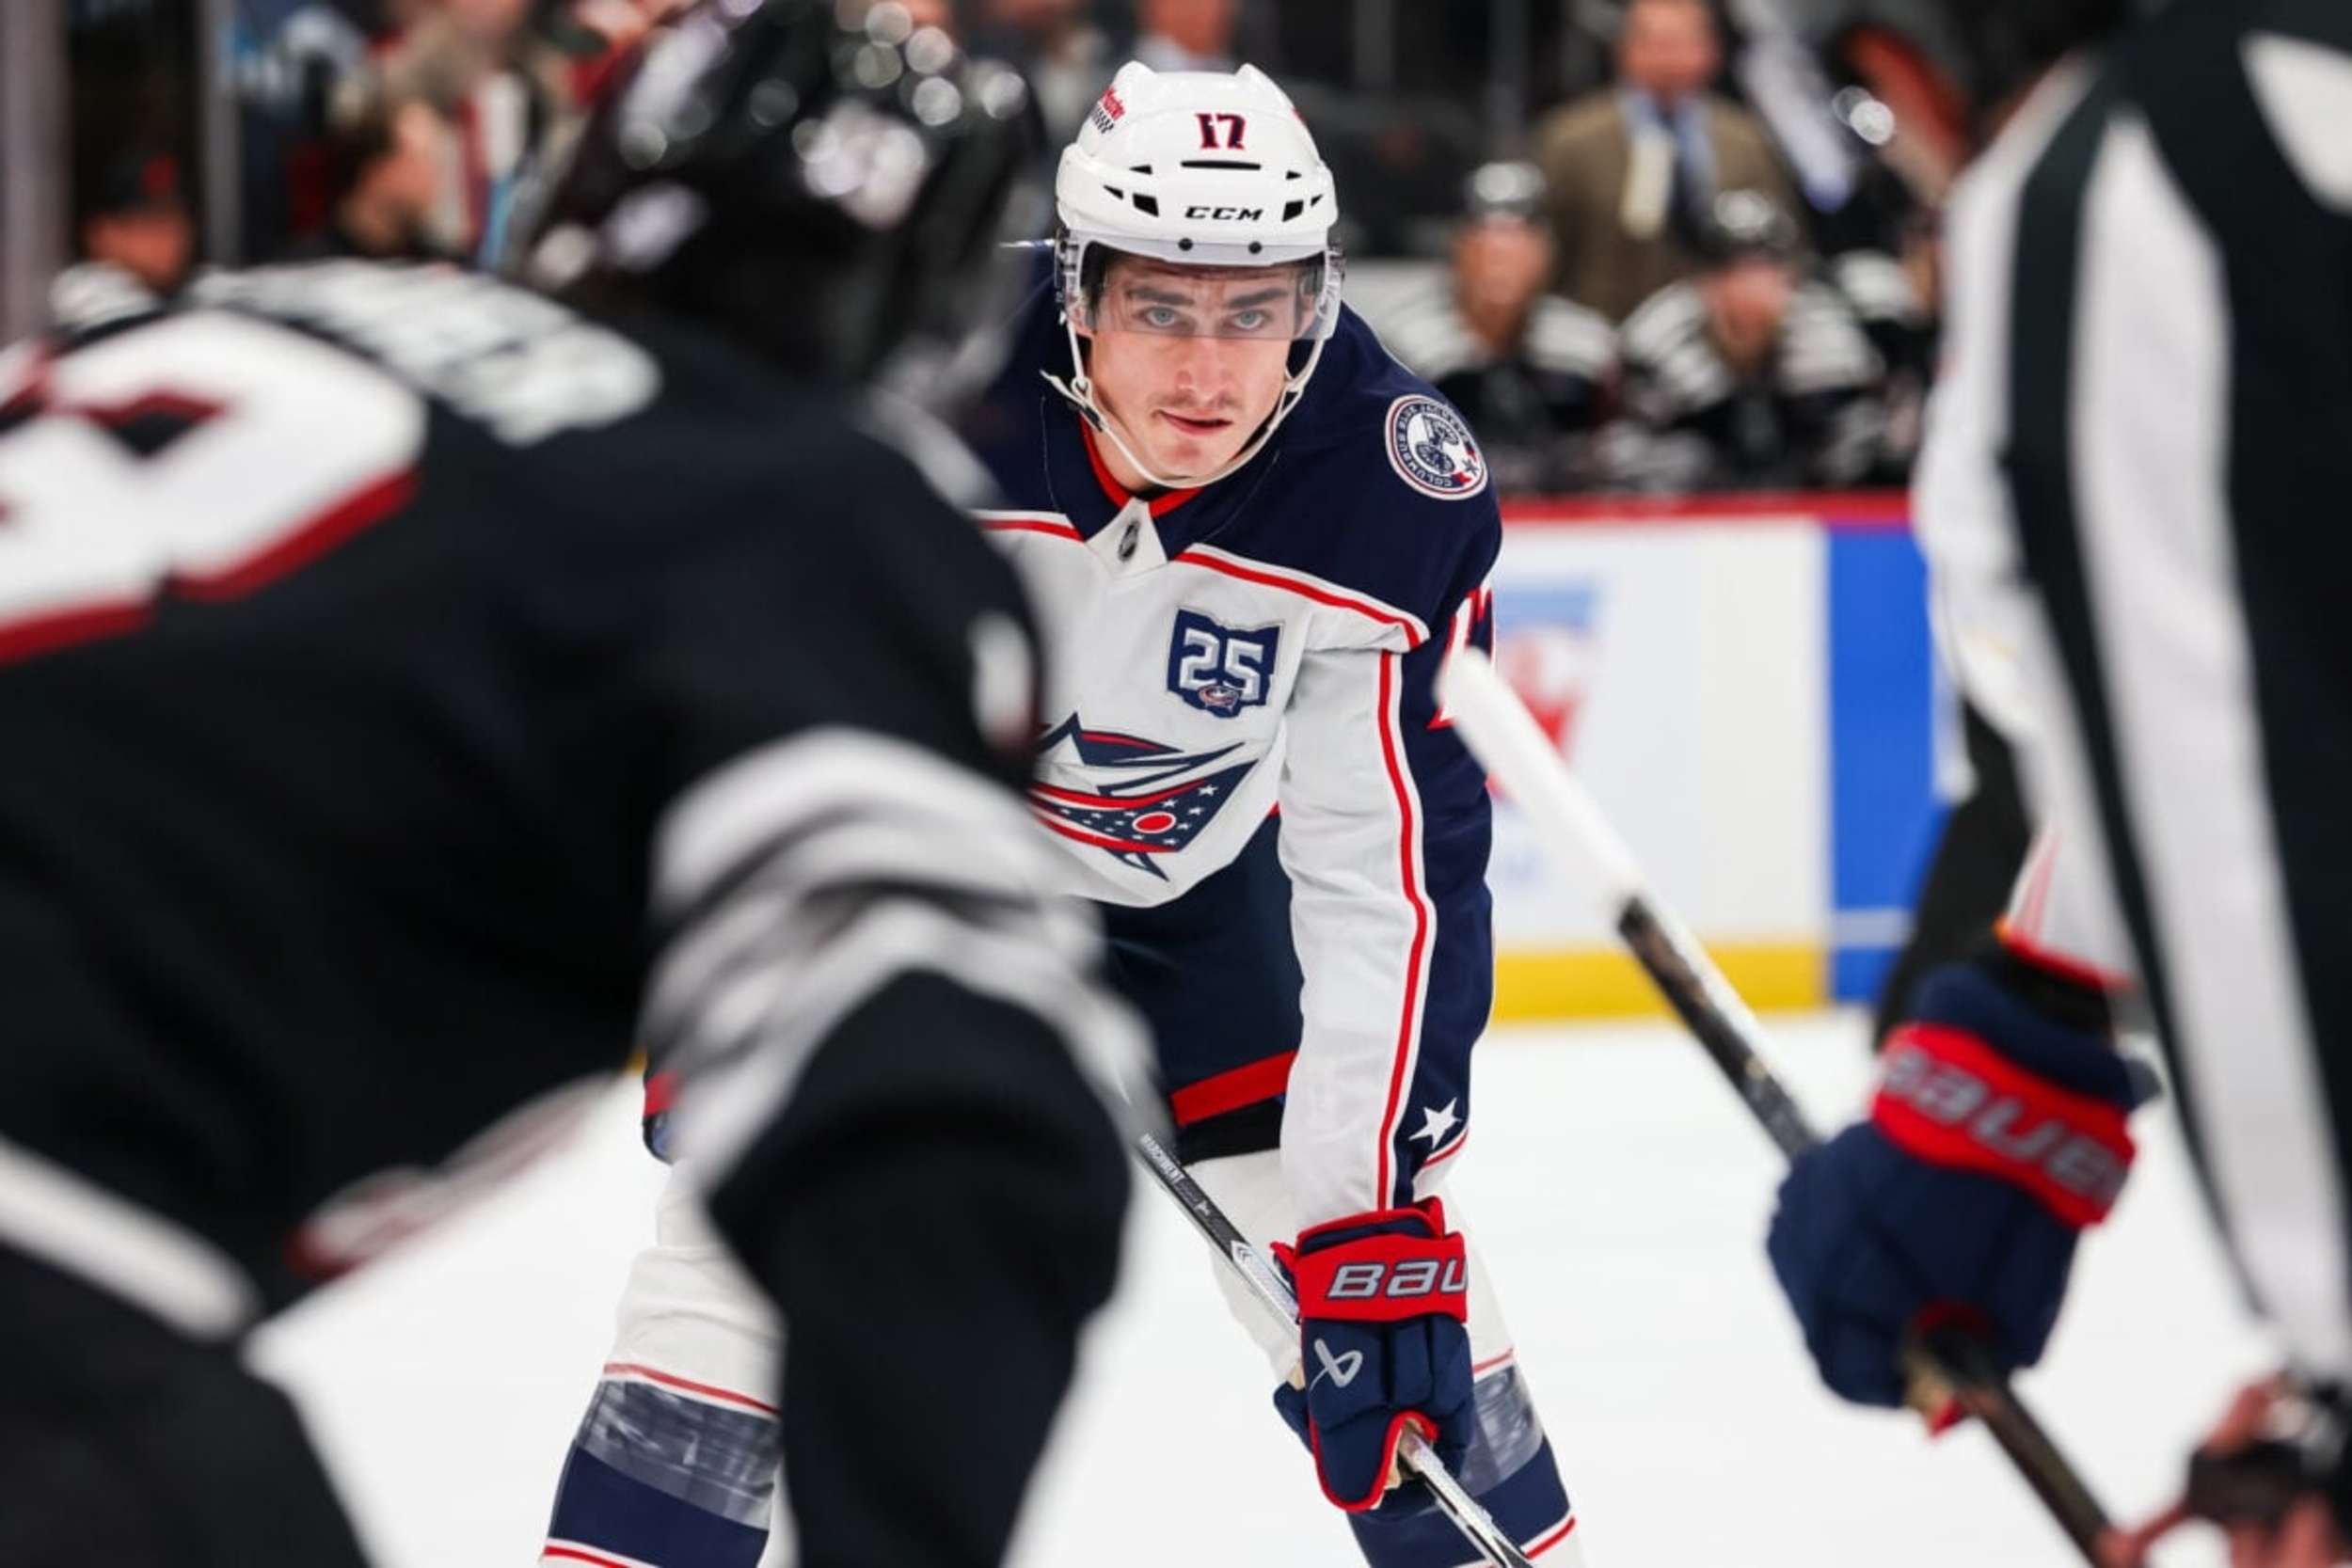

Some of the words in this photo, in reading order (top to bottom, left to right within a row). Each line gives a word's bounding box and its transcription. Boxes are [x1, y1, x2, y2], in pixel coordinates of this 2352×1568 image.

[1195, 112, 1247, 150] 17
[1184, 205, 1263, 221] CCM
[1179, 627, 1264, 702] 25
